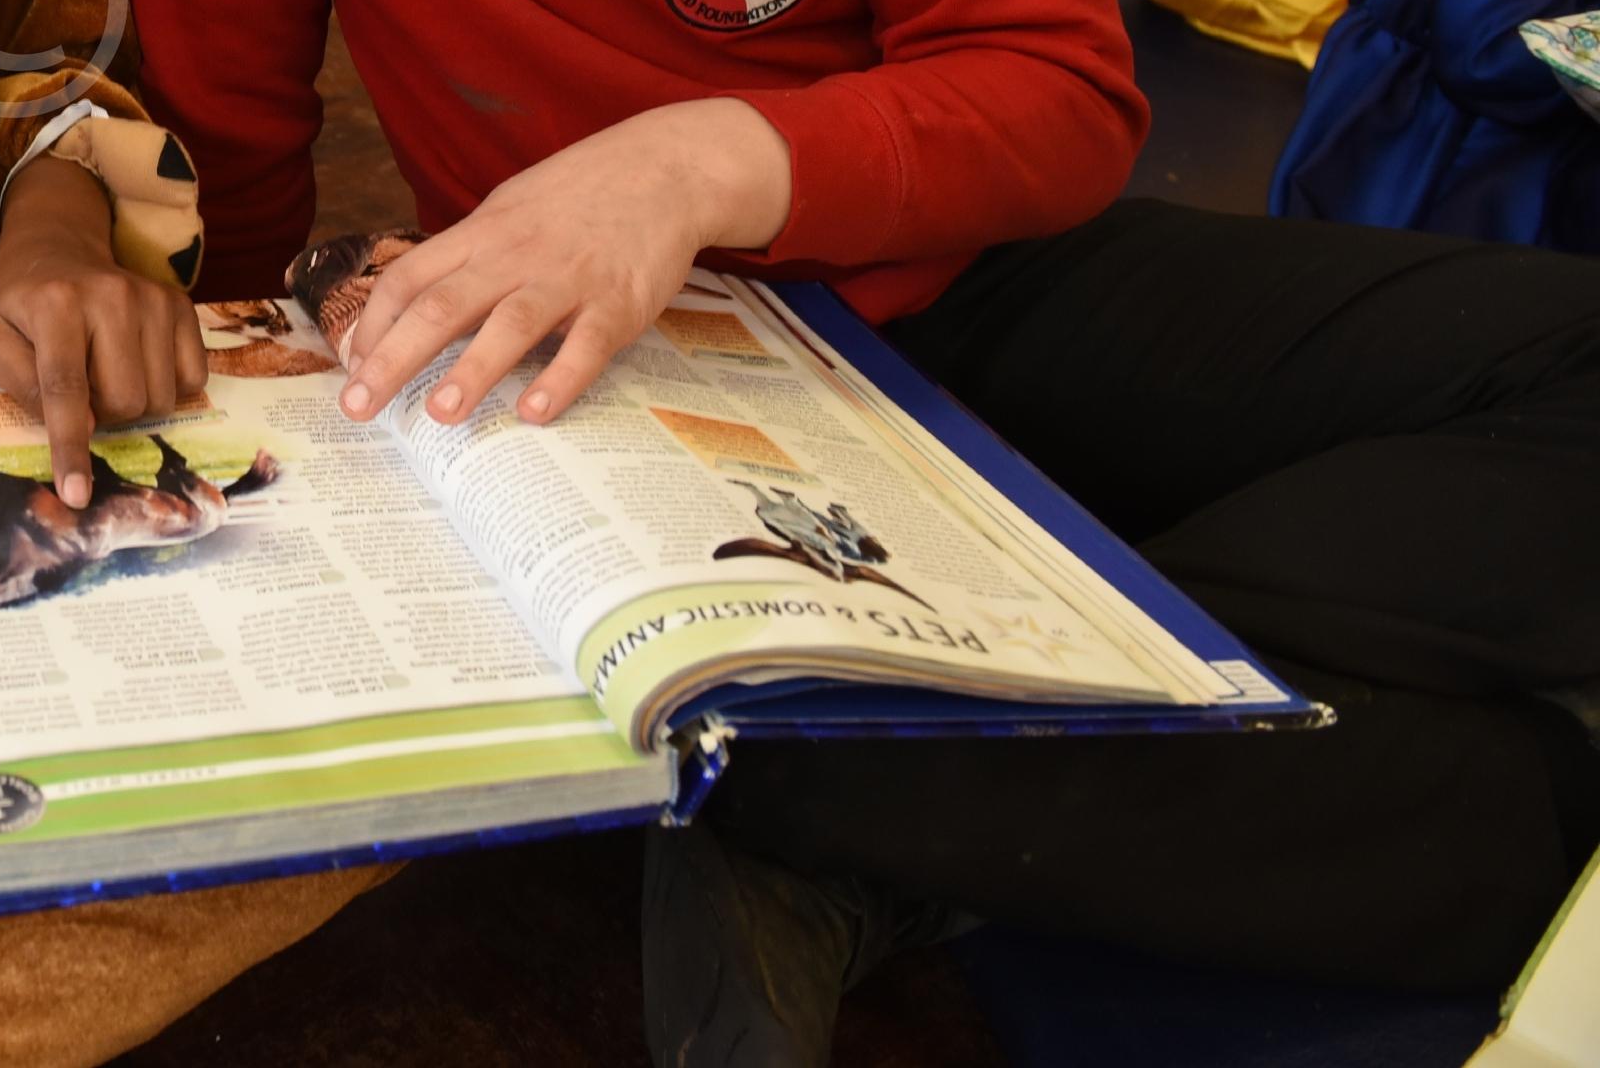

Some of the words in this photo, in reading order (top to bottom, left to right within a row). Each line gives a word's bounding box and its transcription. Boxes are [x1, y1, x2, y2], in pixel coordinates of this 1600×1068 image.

[677, 600, 827, 627] DOMESTIC
[836, 606, 859, 624] &
[867, 611, 991, 655] PETS
